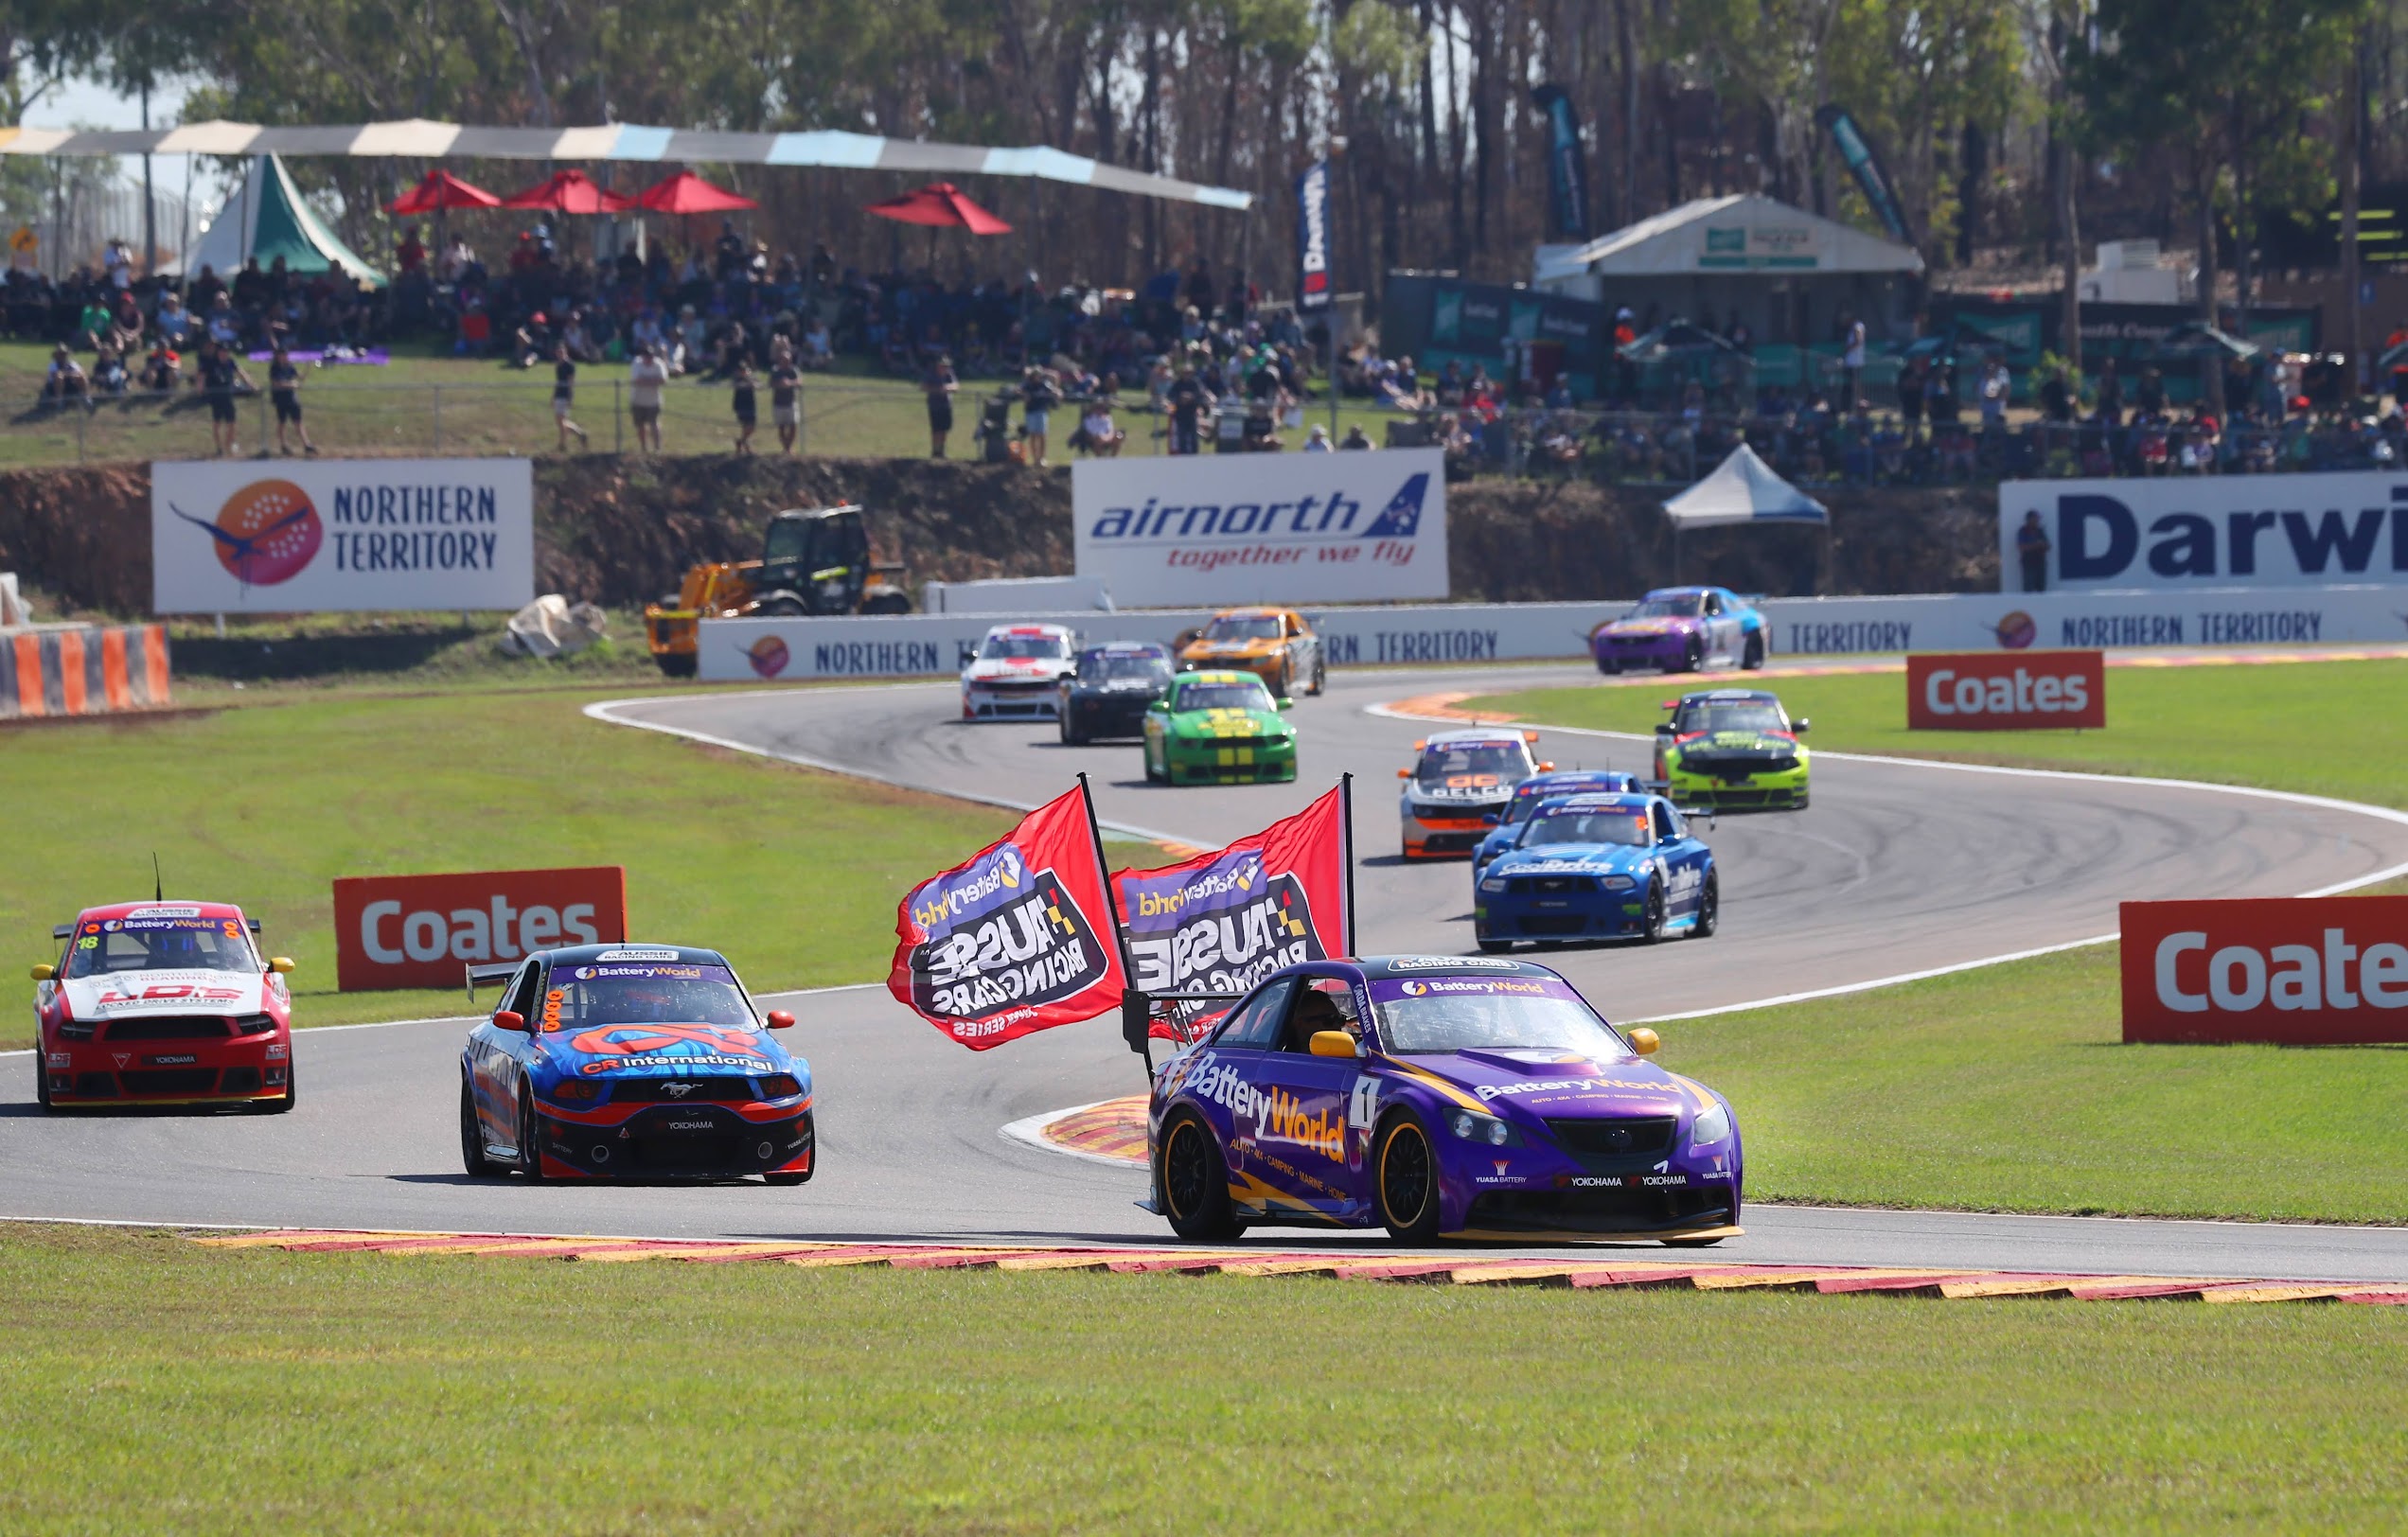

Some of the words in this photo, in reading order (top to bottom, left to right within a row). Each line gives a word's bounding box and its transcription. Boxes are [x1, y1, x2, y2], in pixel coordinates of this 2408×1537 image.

[333, 485, 497, 525] NORTHERN
[1090, 490, 1360, 539] airnorth
[2057, 486, 2408, 581] Darwi
[332, 531, 498, 572] TERRITORY
[1167, 544, 1306, 572] together
[1318, 544, 1361, 562] we
[1372, 539, 1416, 565] fly
[1790, 621, 1913, 653] TERRITORY
[2062, 613, 2184, 647] NORTHERN
[2198, 610, 2322, 644] TERRITORY
[815, 641, 939, 674] NORTHERN
[1375, 629, 1499, 662] TERRITORY
[1925, 668, 2087, 716] Coates
[125, 919, 216, 930] BatteryWorld
[361, 894, 598, 964] Coates
[79, 936, 99, 949] 18
[598, 966, 701, 979] BatteryWorld
[2154, 928, 2408, 1013] Coate
[1429, 981, 1545, 994] BatteryWorld
[1359, 1007, 1372, 1034] BRAKES
[155, 1055, 196, 1064] YOKOHAMA
[582, 1059, 619, 1075] CR
[623, 1053, 773, 1071] International
[1360, 1082, 1372, 1122] 1
[1473, 1078, 1682, 1102] BatteryWorld
[1186, 1051, 1345, 1164] BatteryWorld
[668, 1121, 714, 1131] YOKOHAMA
[1230, 1139, 1250, 1156] AUTO
[1266, 1155, 1295, 1178] CAMPING
[1299, 1170, 1323, 1194] MARINE
[1571, 1176, 1622, 1187] YOKOHAMA
[1642, 1175, 1687, 1186] YOKOHAMA
